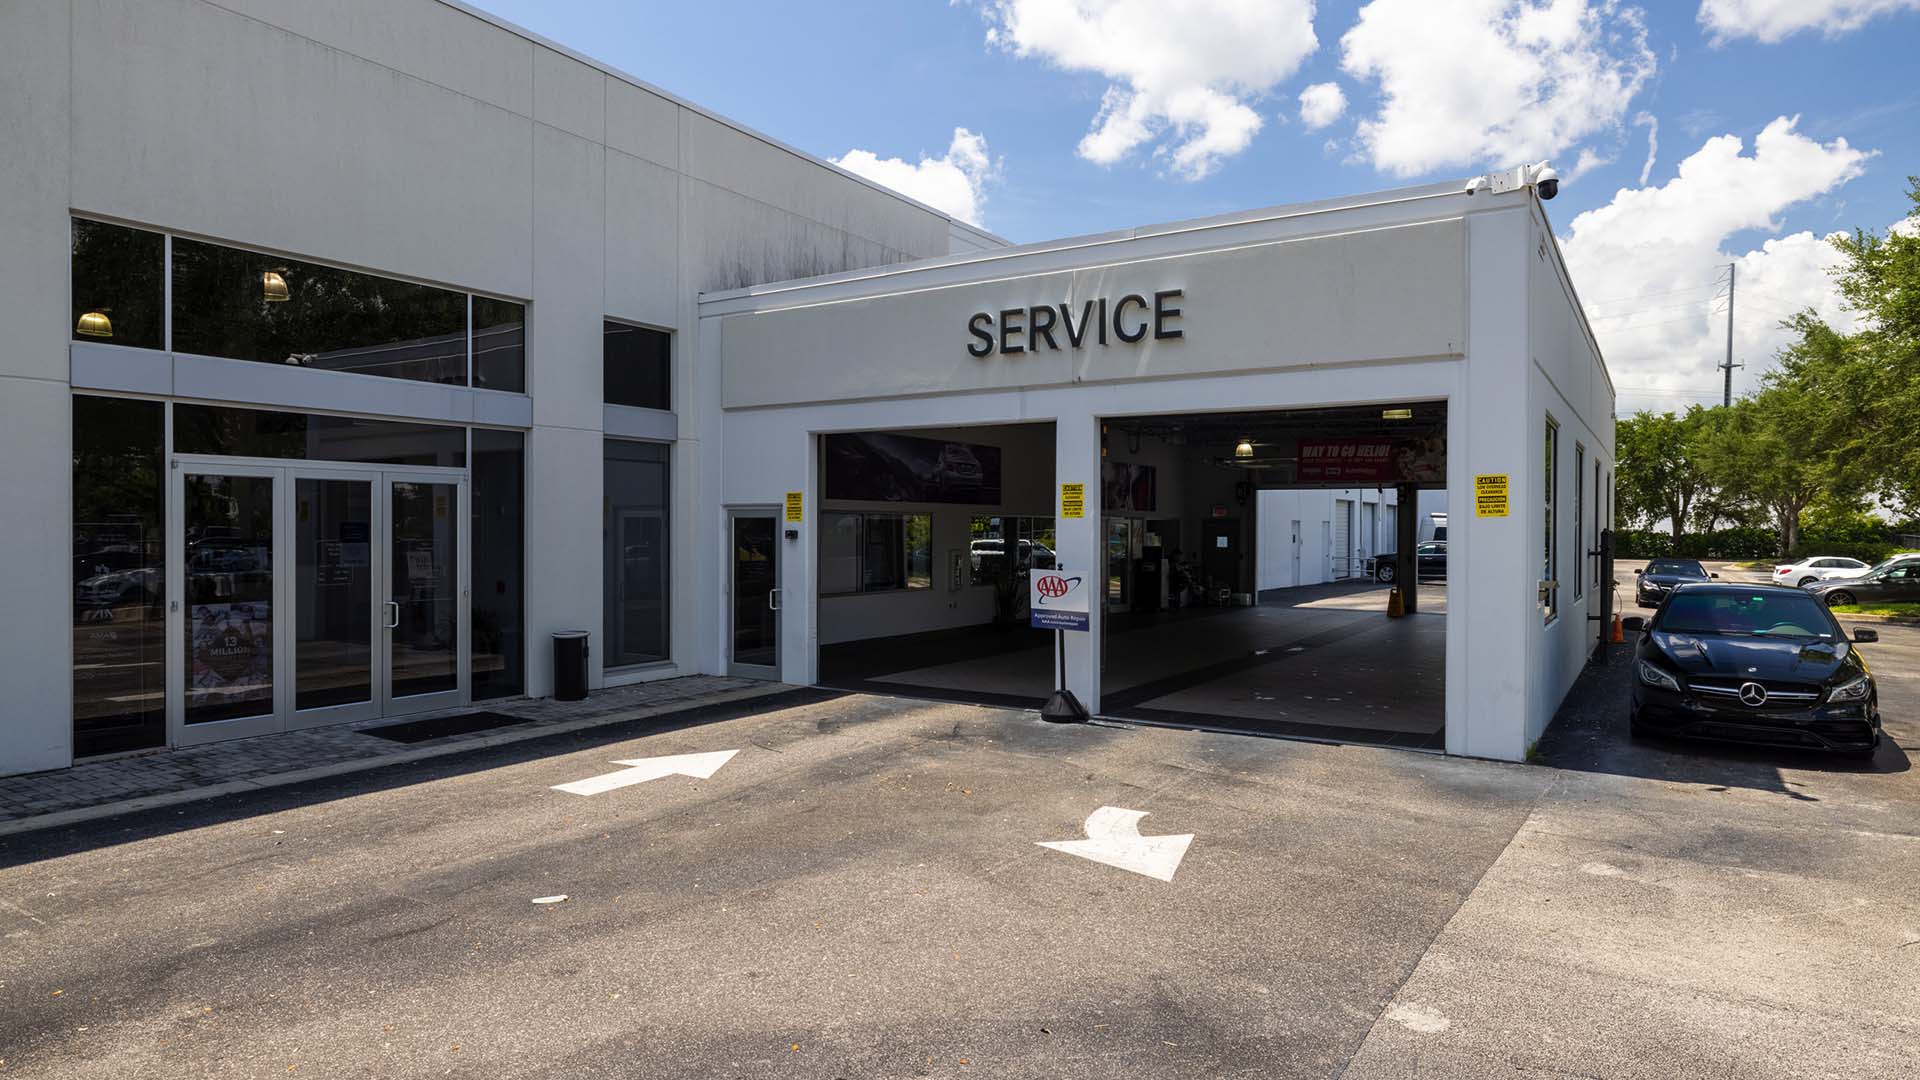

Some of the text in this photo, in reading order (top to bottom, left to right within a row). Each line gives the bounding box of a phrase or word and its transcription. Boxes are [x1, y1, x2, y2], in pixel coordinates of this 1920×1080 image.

[967, 289, 1184, 358] SERVICE
[1302, 446, 1325, 458] WAY
[1327, 445, 1340, 457] TO
[1340, 445, 1357, 457] GO
[1039, 576, 1067, 597] AAA
[224, 636, 238, 647] 13
[210, 646, 250, 657] MILLION
